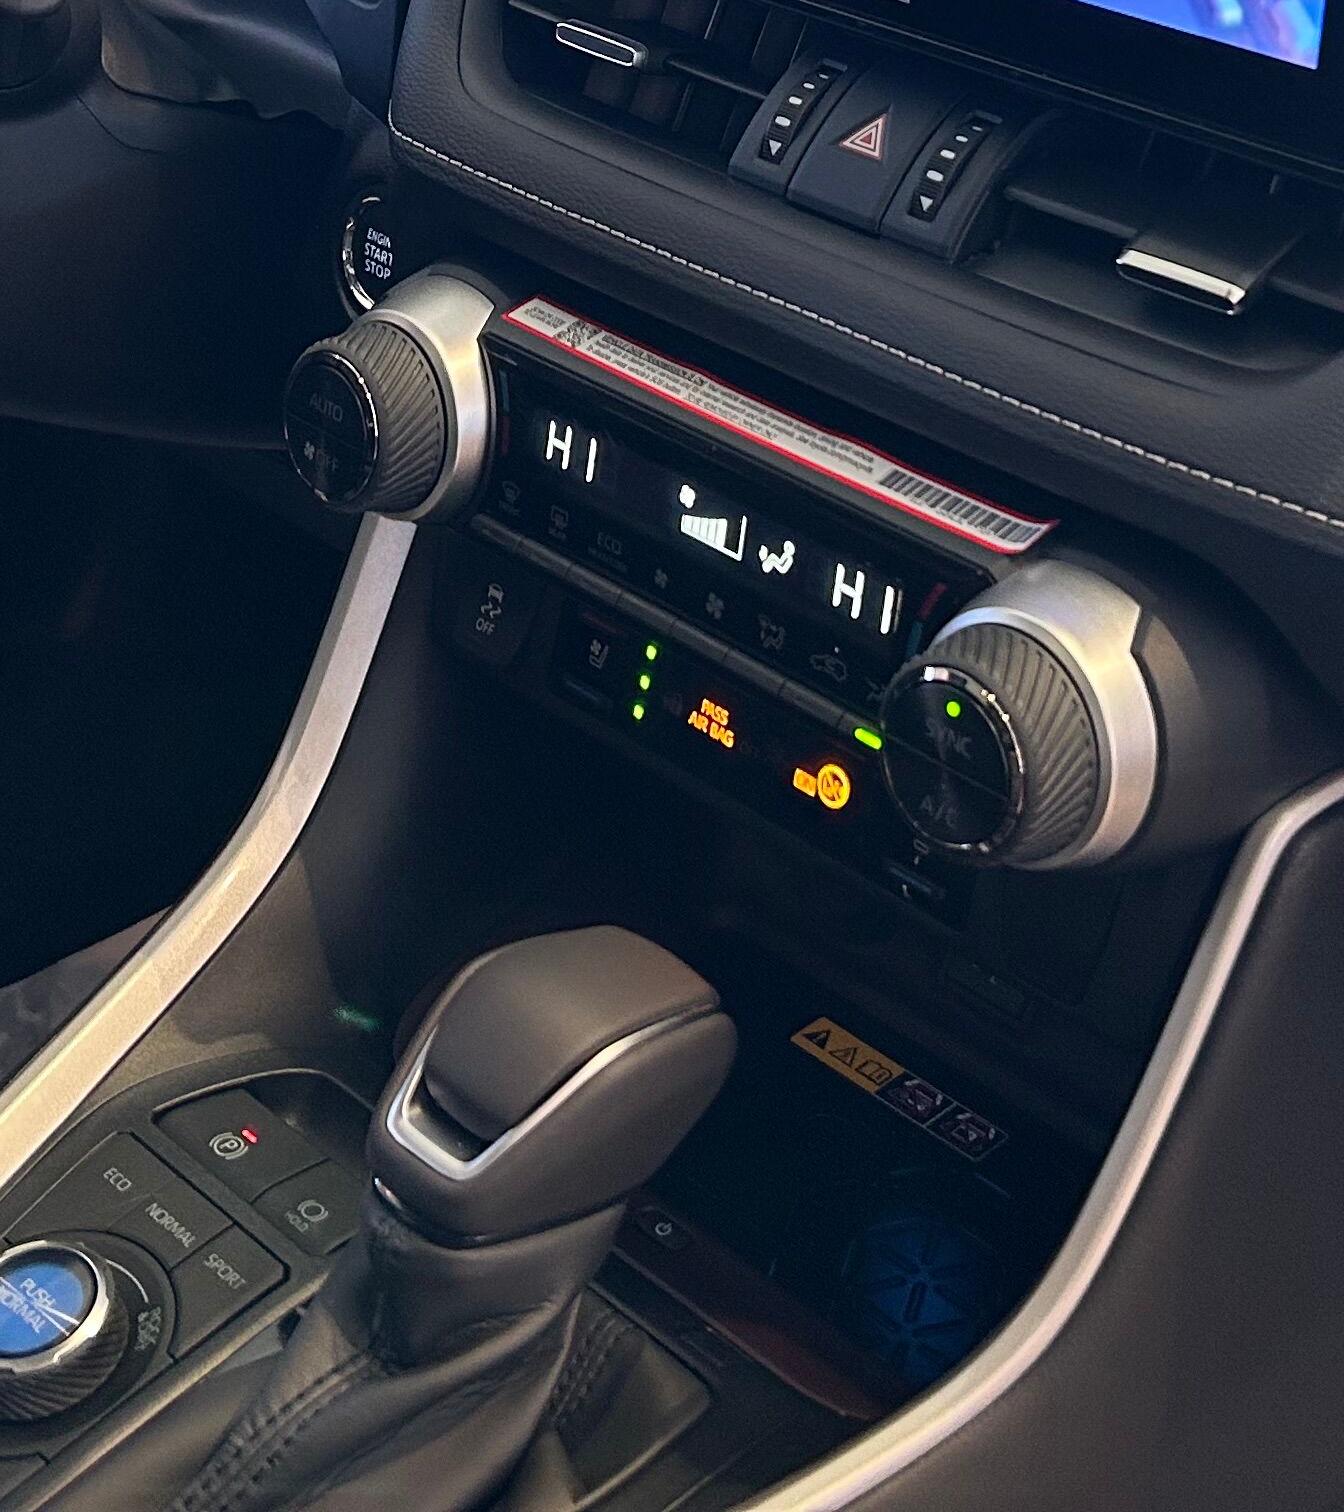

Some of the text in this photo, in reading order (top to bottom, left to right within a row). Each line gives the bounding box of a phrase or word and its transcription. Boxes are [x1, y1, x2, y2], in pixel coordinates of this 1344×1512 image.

[365, 242, 393, 267] START
[365, 258, 391, 279] STOP
[309, 392, 343, 422] AUTO
[475, 617, 496, 635] OFF
[701, 698, 729, 726] PASS
[688, 710, 735, 748] AIR BAG
[103, 1167, 133, 1191] ECO
[145, 1202, 197, 1248] NORMAL
[285, 1210, 309, 1233] HOLD
[203, 1253, 247, 1290] SPORT
[19, 1278, 56, 1308] PUSH
